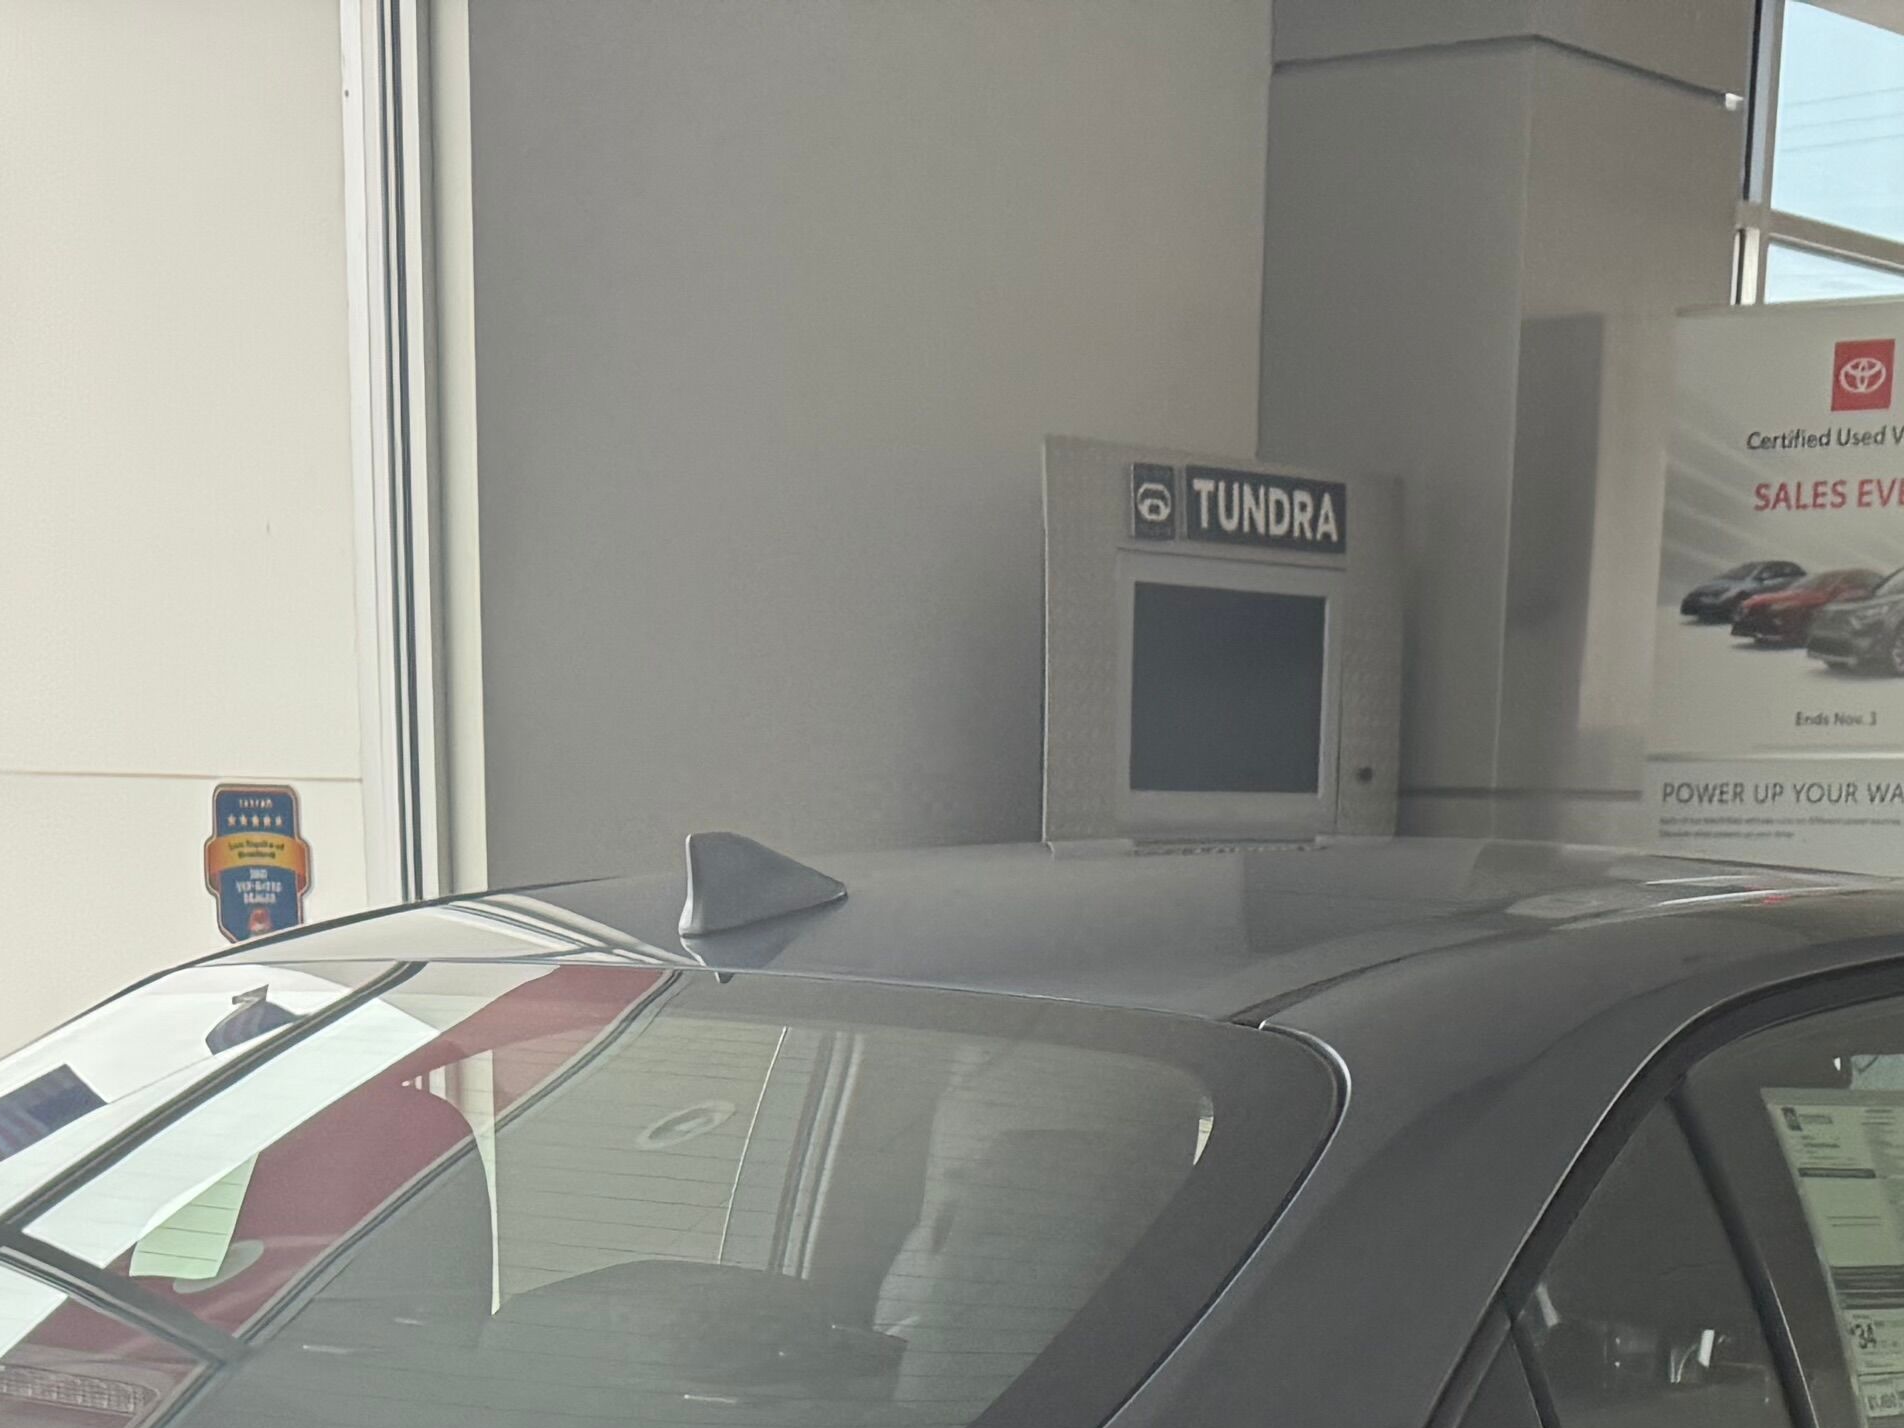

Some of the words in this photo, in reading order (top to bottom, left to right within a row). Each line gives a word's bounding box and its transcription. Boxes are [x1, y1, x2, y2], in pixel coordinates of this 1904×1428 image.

[1747, 428, 1832, 450] Certified
[1837, 425, 1887, 447] Used
[1754, 479, 1848, 512] SALES
[1193, 478, 1339, 543] TUNDRA
[1795, 711, 1829, 727] Ends
[1662, 782, 1745, 804] POWER
[1753, 782, 1784, 804] UP
[1793, 782, 1859, 804] YOUR
